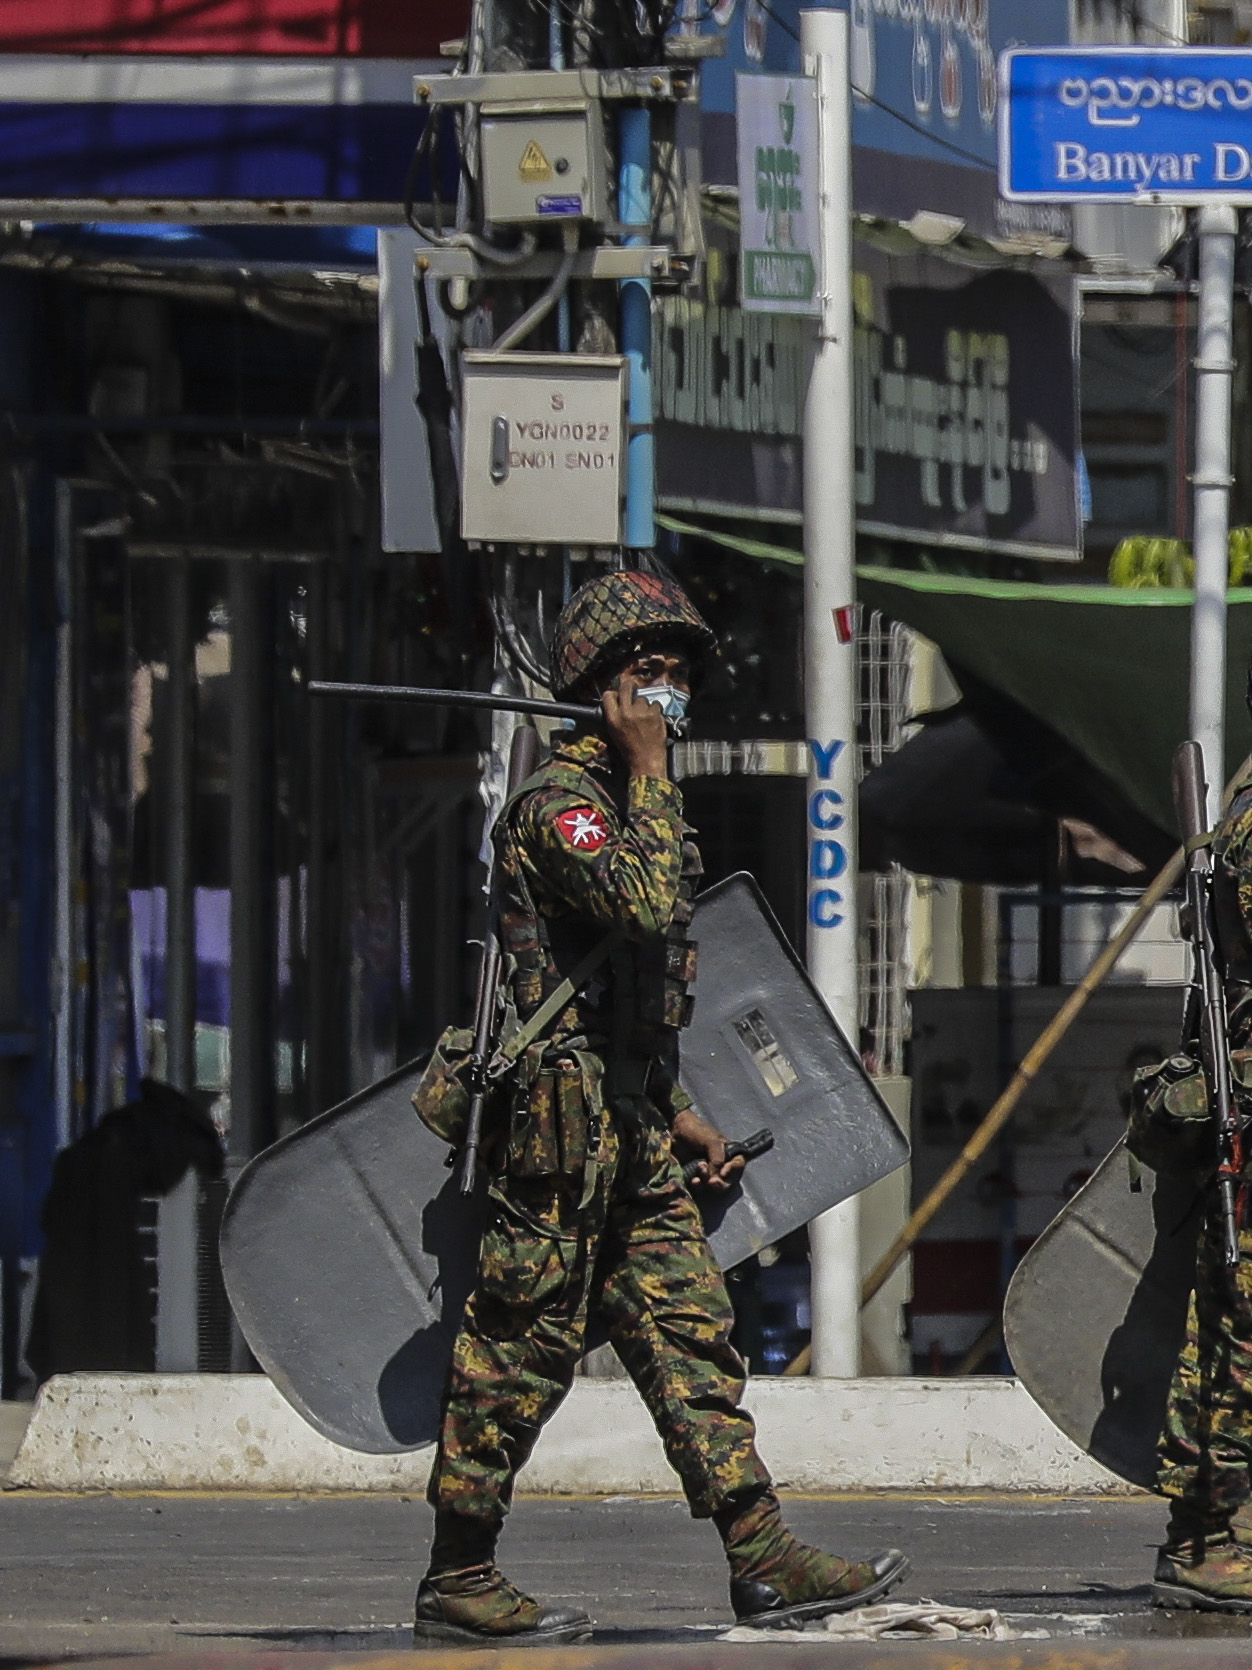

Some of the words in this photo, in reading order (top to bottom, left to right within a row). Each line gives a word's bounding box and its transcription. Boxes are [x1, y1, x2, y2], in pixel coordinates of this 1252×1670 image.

[1055, 141, 1201, 192] Banyar
[551, 393, 565, 411] S
[516, 421, 611, 441] YGN0022
[565, 452, 616, 470] SN01
[808, 739, 848, 929] YCDC
